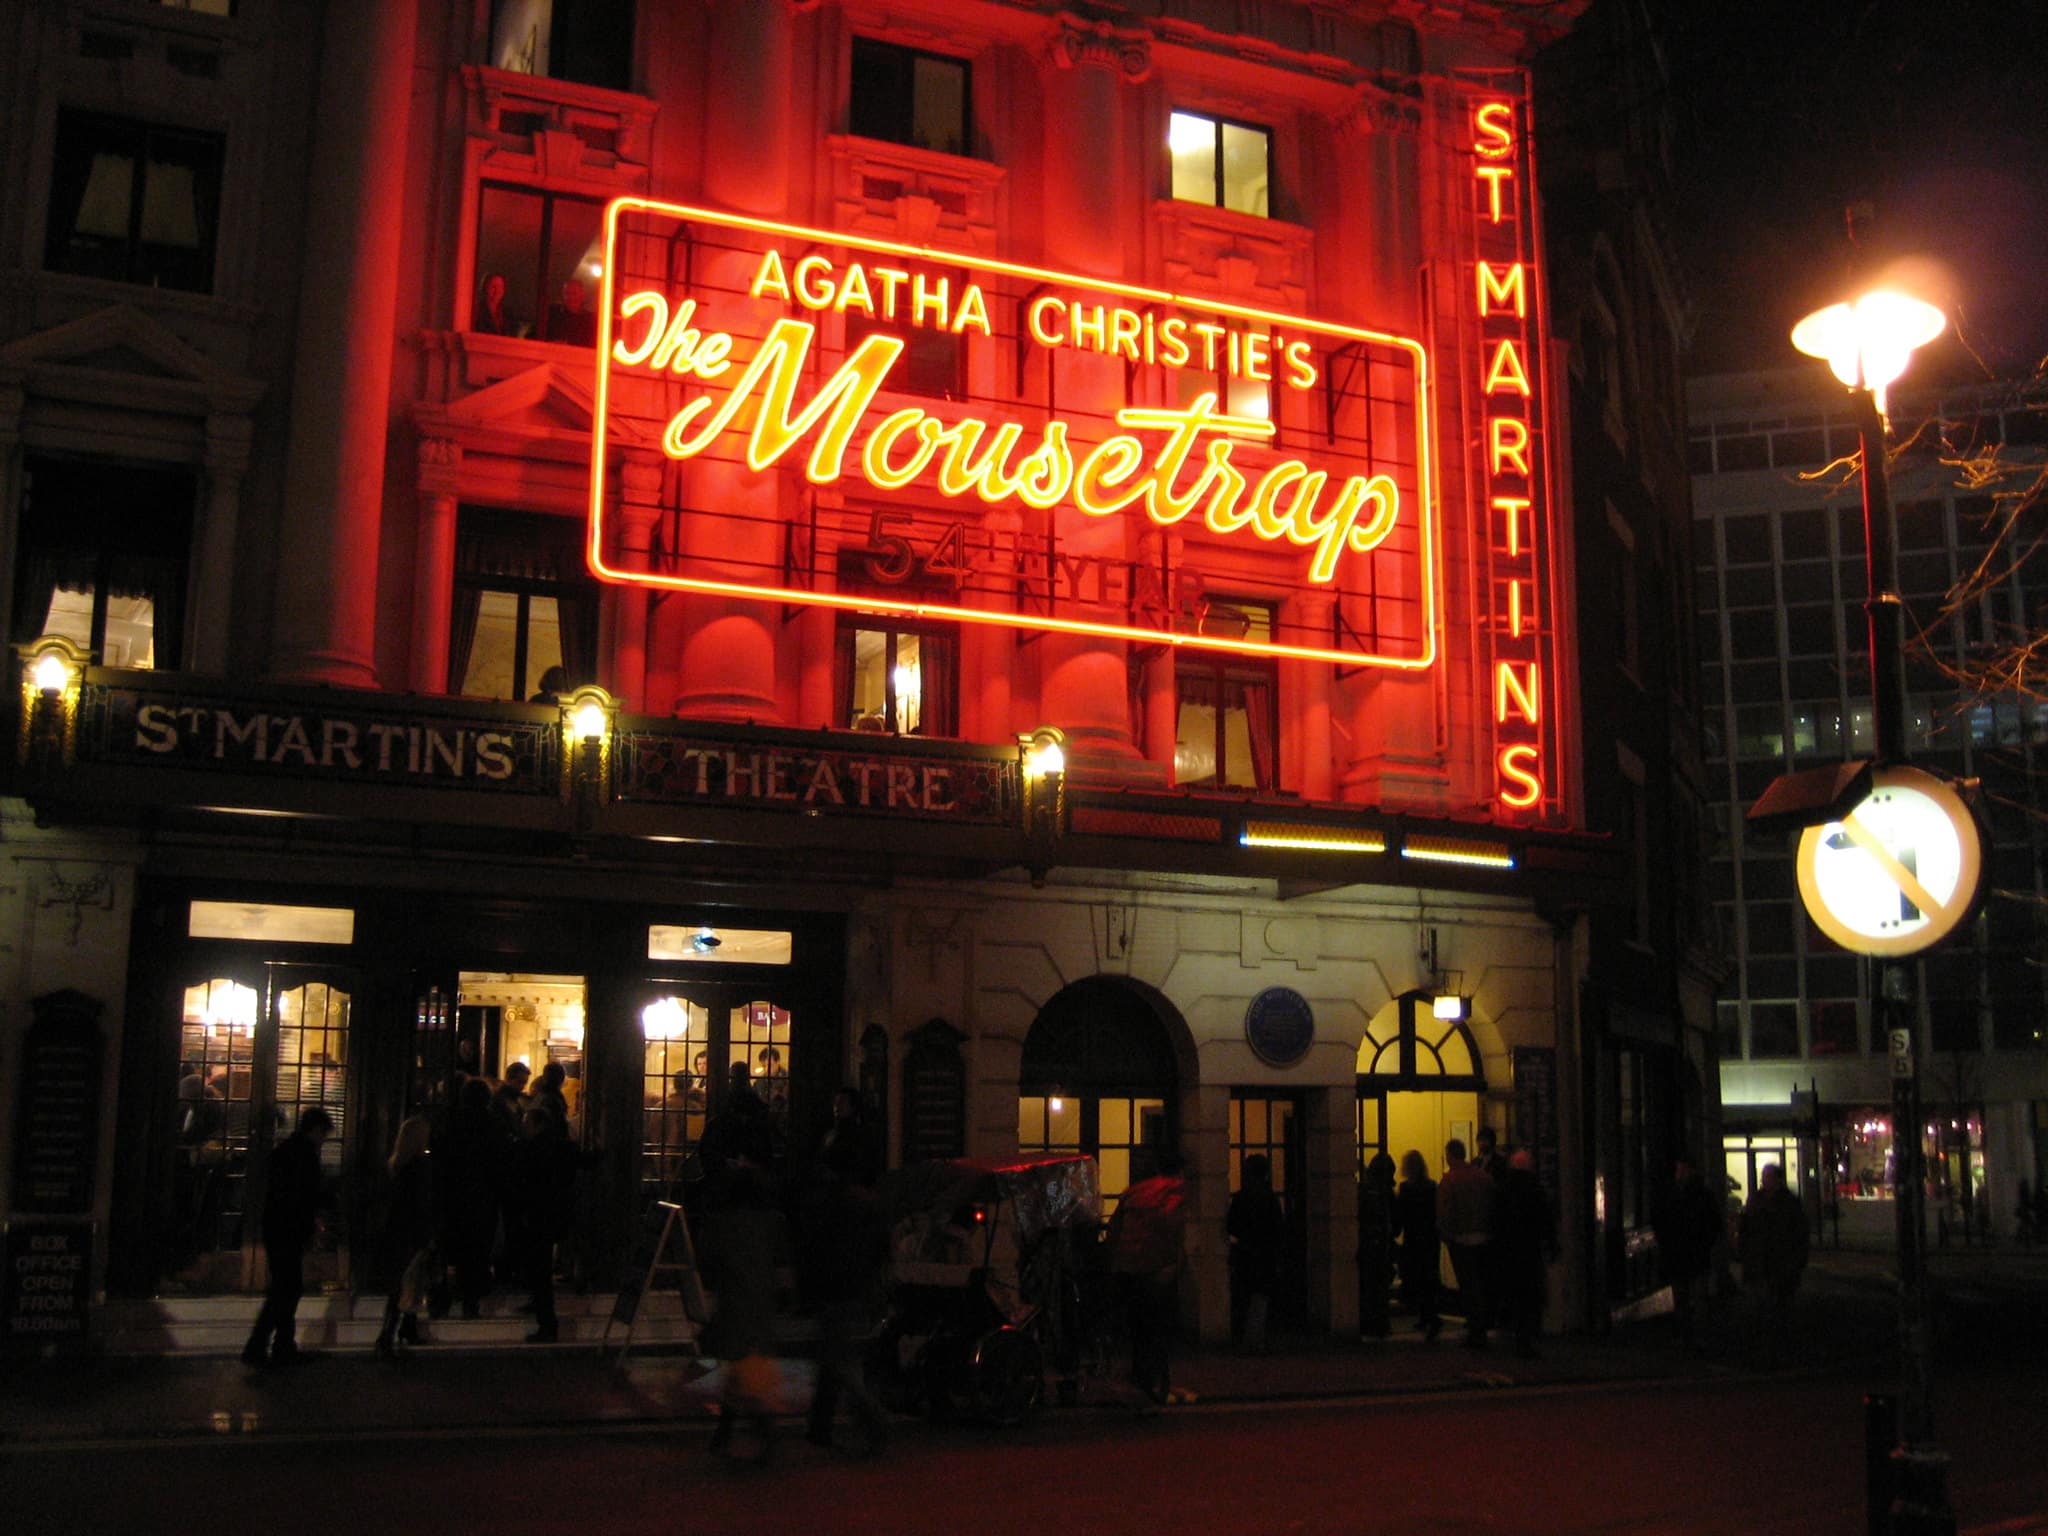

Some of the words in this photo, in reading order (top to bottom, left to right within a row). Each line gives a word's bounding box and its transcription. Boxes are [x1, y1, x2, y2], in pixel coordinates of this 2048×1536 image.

[1474, 103, 1512, 223] ST
[612, 291, 733, 378] The
[751, 249, 991, 336] AGATHA
[1028, 297, 1318, 389] CHRISTIE'S
[663, 319, 1402, 584] Mousetrap
[1476, 261, 1541, 807] MARTINS
[213, 710, 514, 780] MARTIN'S
[683, 749, 955, 811] THEATRE
[16, 1255, 82, 1271] OFFICE
[30, 1235, 68, 1250] BOX
[19, 1295, 74, 1312] FROM
[22, 1275, 74, 1291] OPEN
